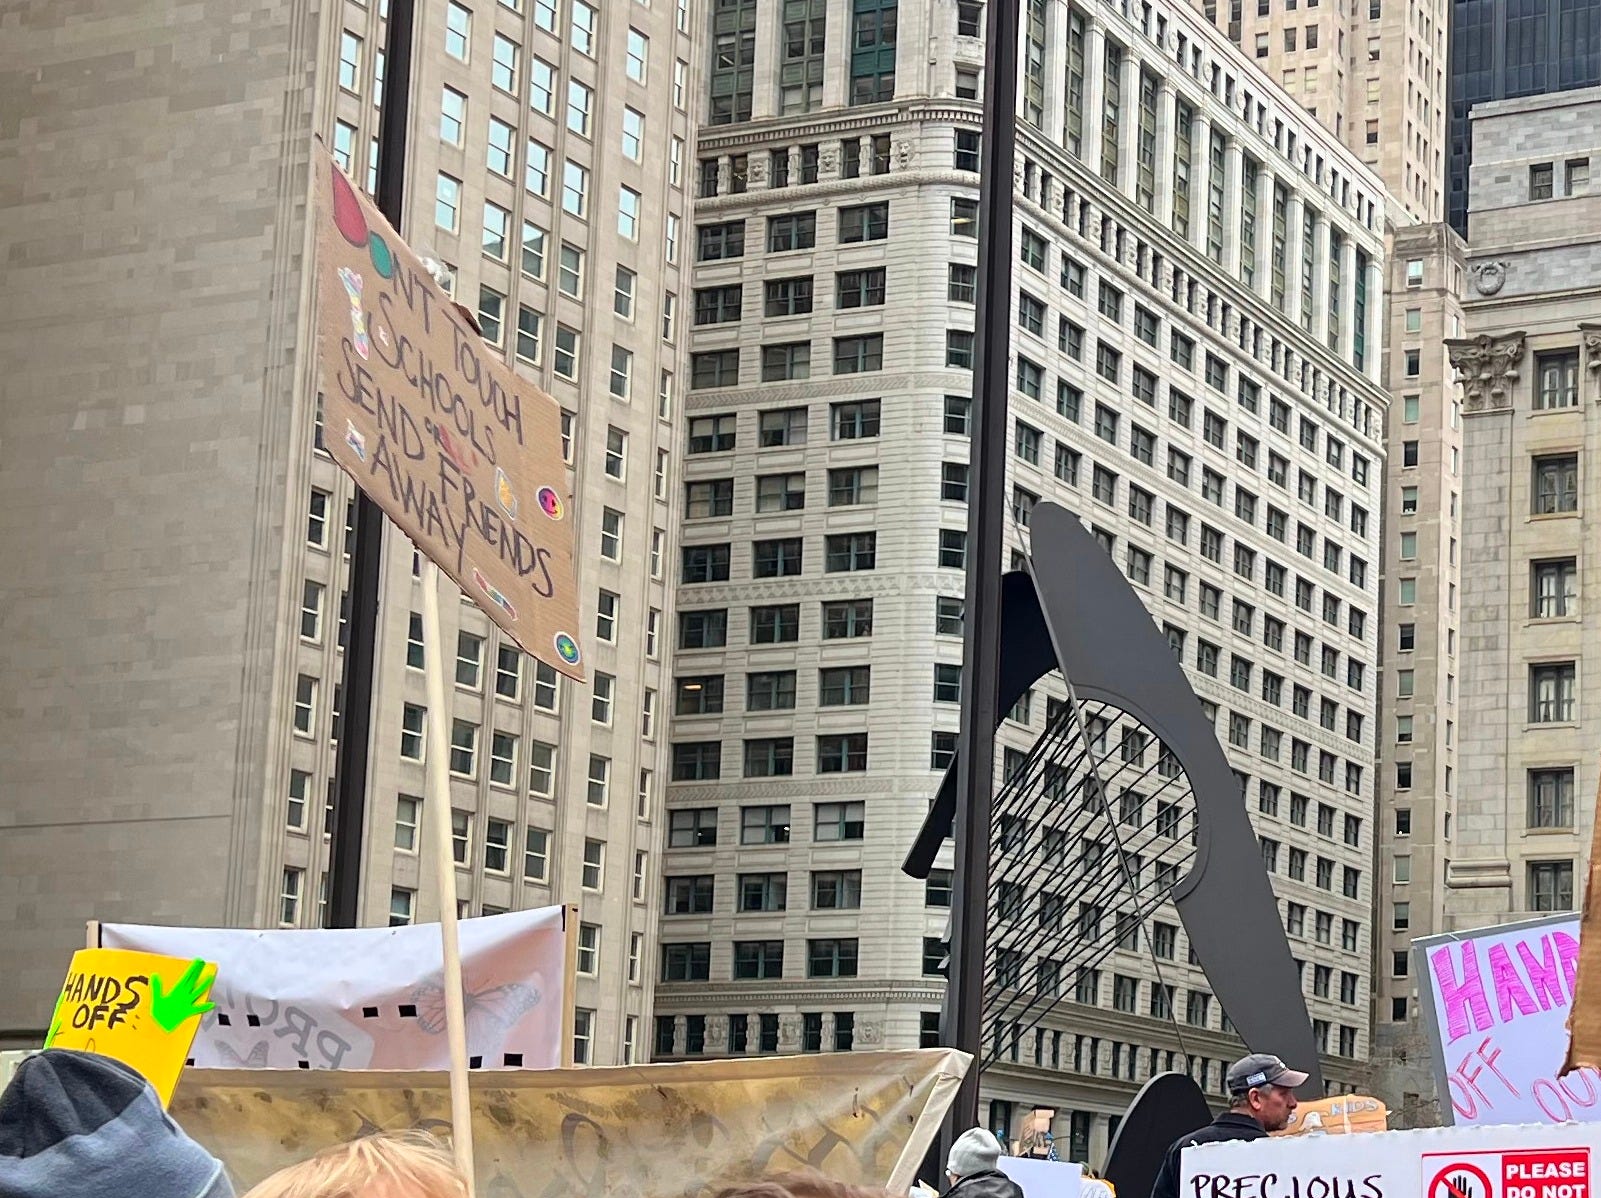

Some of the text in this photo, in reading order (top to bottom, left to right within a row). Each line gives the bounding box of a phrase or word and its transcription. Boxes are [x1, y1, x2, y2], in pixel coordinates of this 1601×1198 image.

[368, 291, 497, 466] SCHOOLS
[442, 307, 524, 446] TOUCH
[337, 336, 424, 460] SEND
[438, 452, 554, 598] FRIENDS
[371, 434, 467, 573] AWAY
[65, 972, 149, 1010] HANDS
[1506, 1162, 1585, 1179] PLEASE
